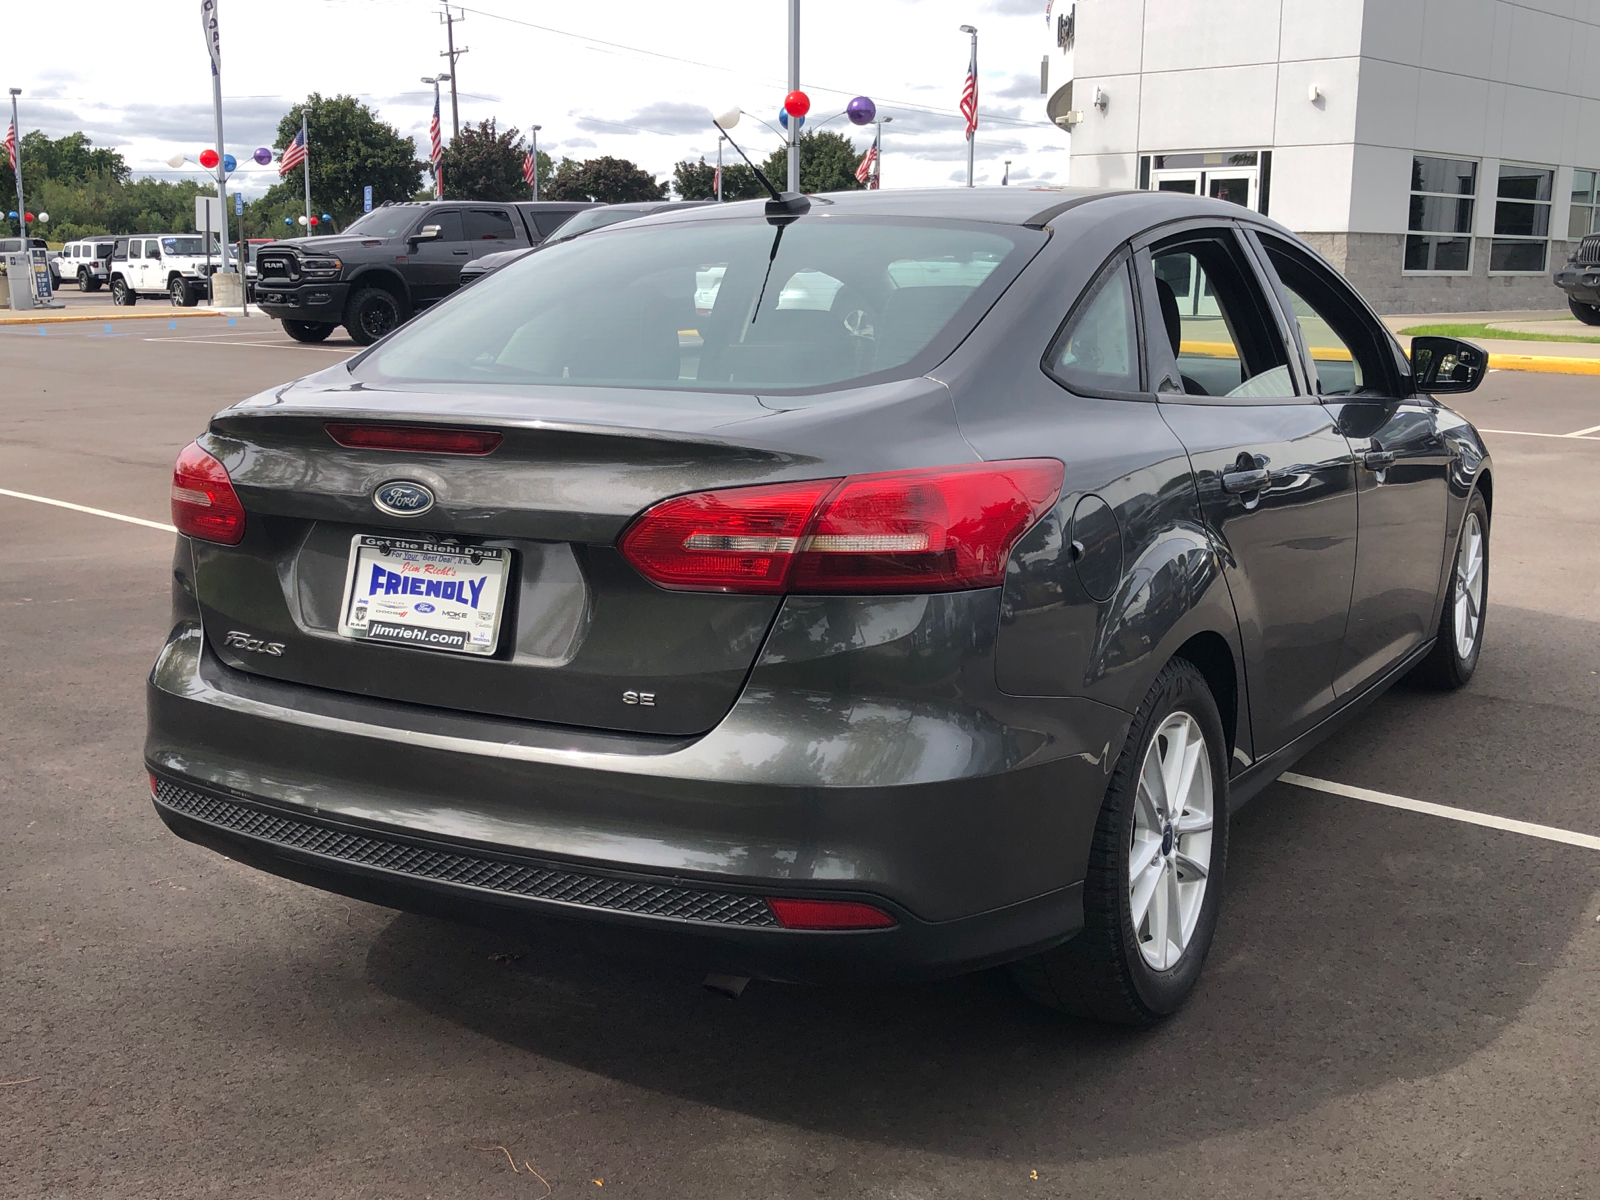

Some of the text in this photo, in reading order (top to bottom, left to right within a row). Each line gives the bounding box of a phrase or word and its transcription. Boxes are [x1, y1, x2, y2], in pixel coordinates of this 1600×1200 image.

[386, 488, 420, 508] Ford
[365, 538, 497, 557] Get the Riehl Deal
[391, 550, 403, 558] For
[403, 552, 419, 561] Your
[400, 562, 457, 577] Jim Riehl's
[368, 563, 488, 610] FRIENDLY
[417, 602, 432, 613] Ford
[441, 610, 468, 619] MOKE
[369, 623, 463, 646] jimriehl.com
[622, 691, 655, 706] SE
